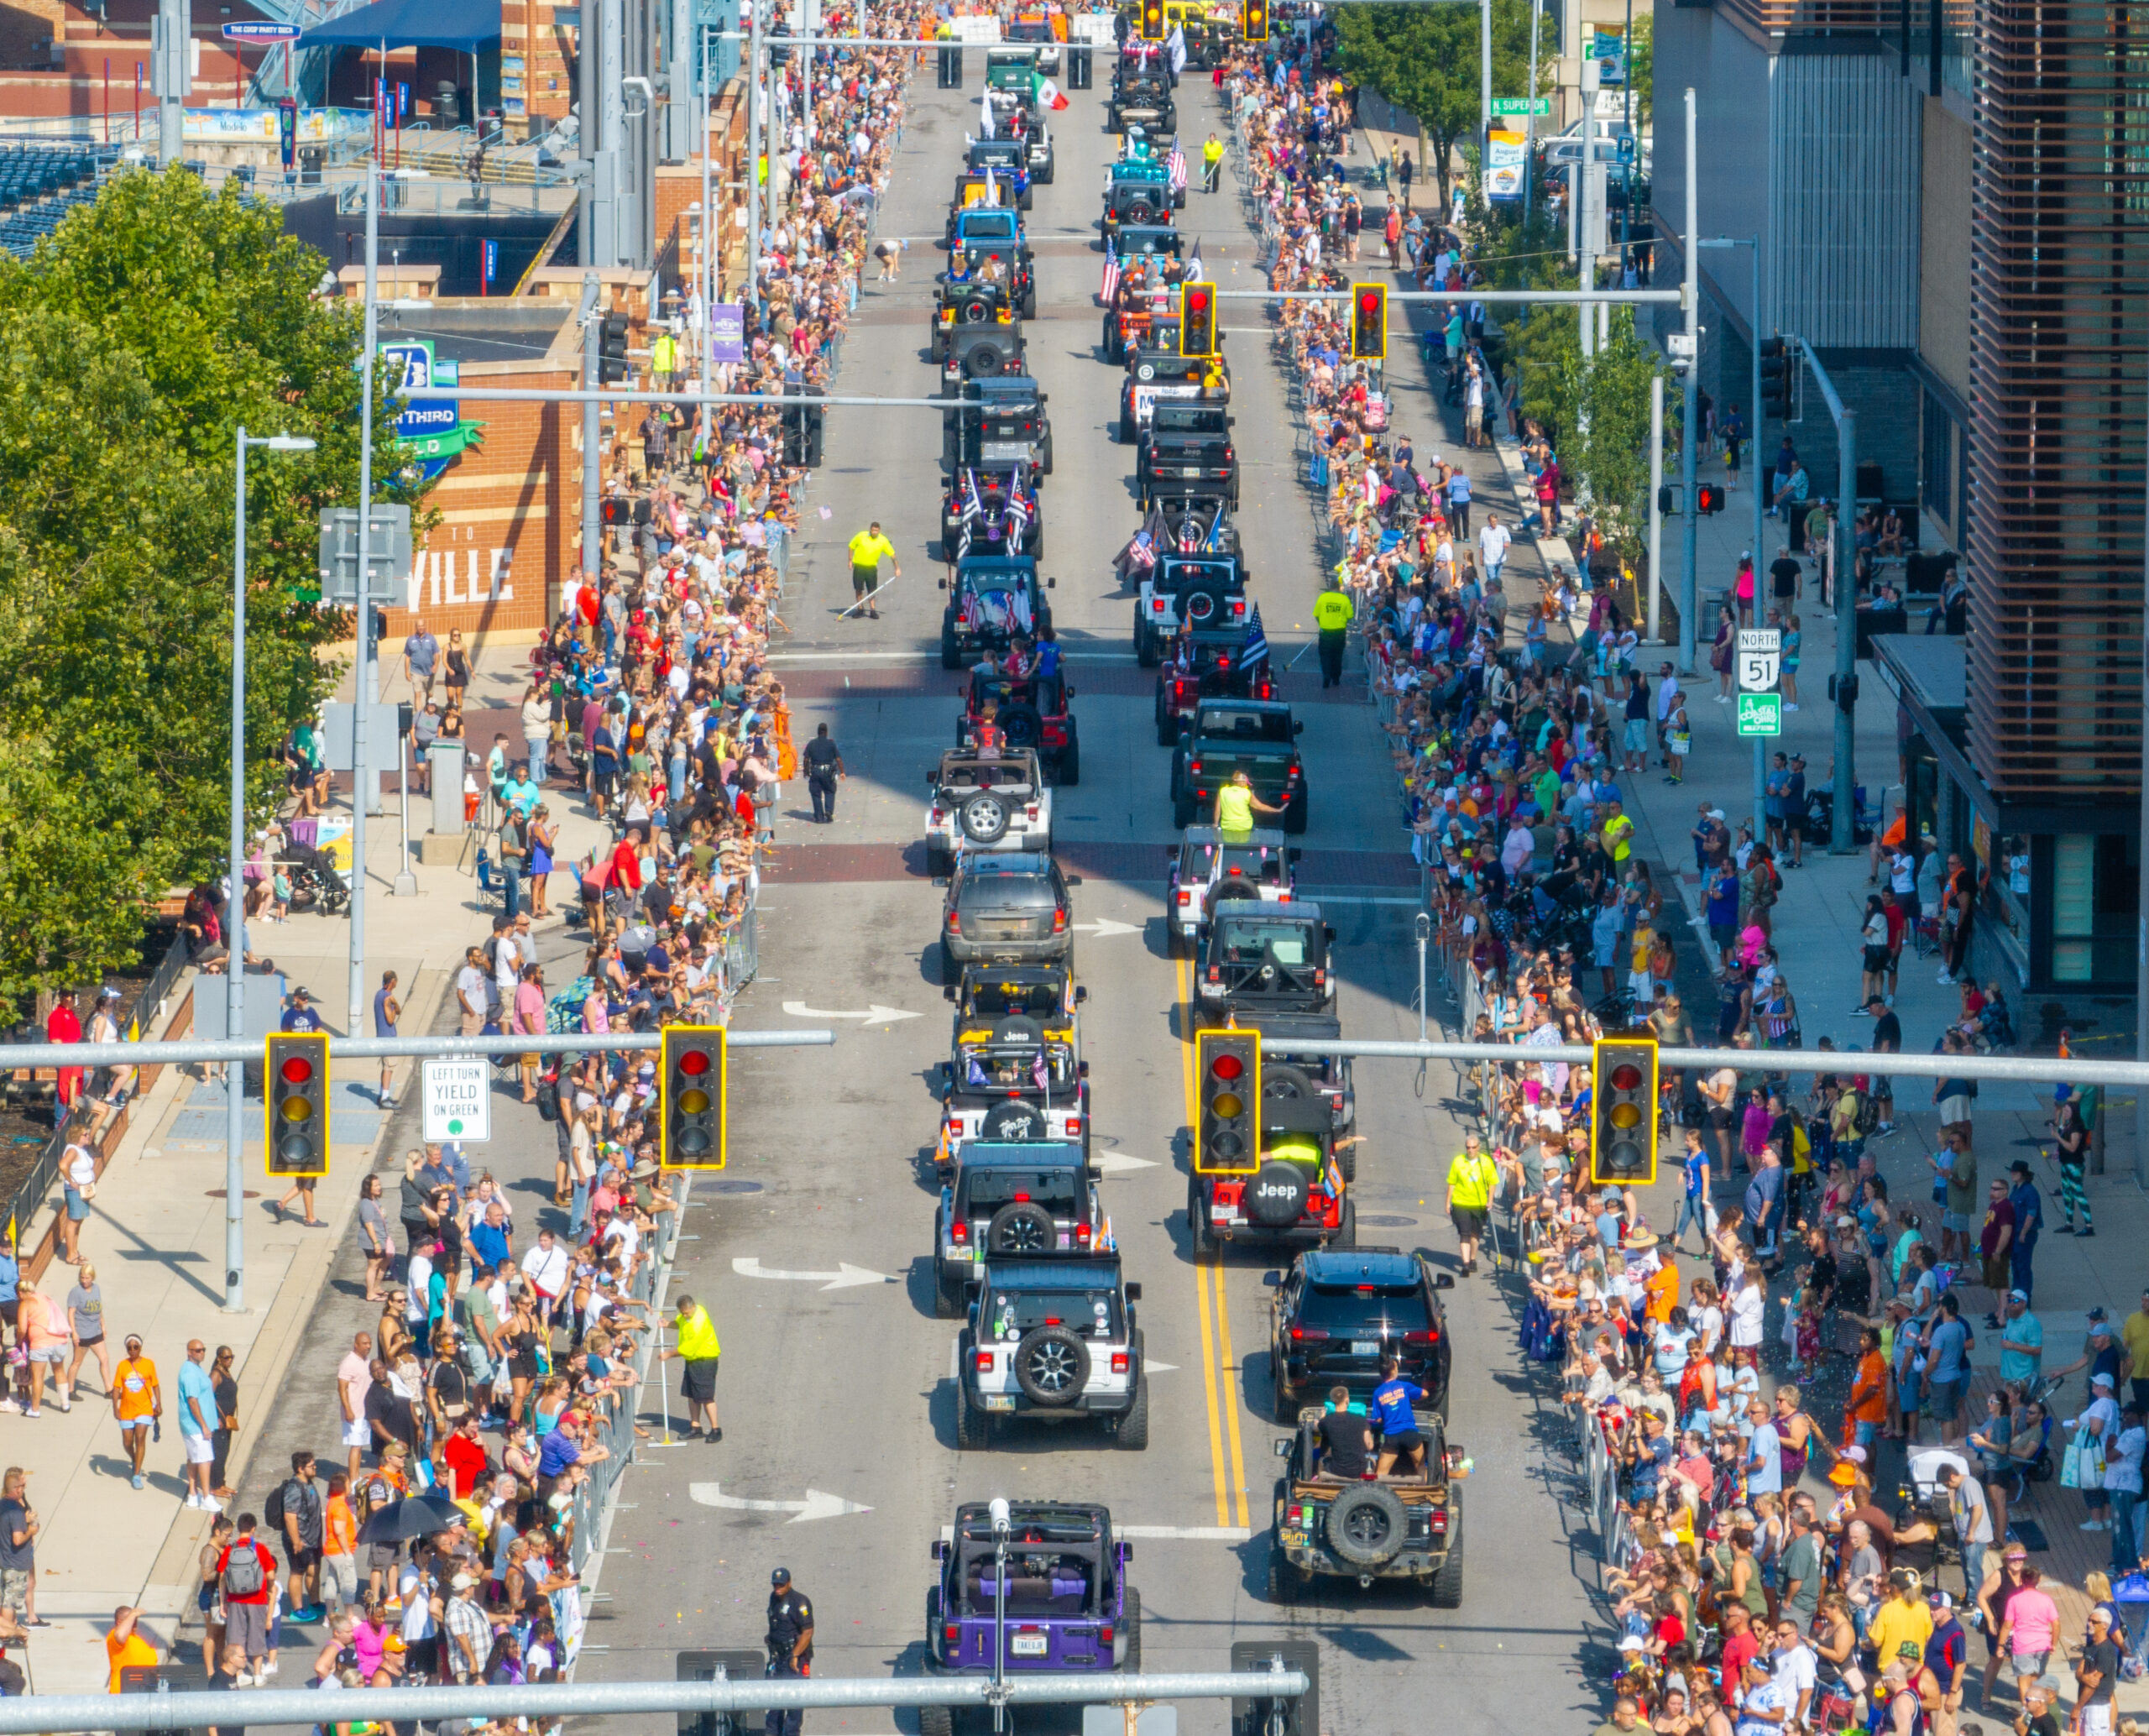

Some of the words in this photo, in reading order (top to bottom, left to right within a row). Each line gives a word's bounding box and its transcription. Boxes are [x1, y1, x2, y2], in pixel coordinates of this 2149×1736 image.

[1493, 100, 1501, 110] N.
[1503, 100, 1546, 111] SUPEROR
[405, 410, 454, 424] THIRD
[1183, 447, 1201, 457] Jeep
[452, 526, 473, 541] TO
[1742, 634, 1778, 646] NORTH
[1749, 660, 1770, 682] 51
[984, 732, 993, 748] 5
[1004, 1031, 1029, 1043] Jeep
[432, 1068, 455, 1080] LEFT
[457, 1068, 480, 1080] TURN
[436, 1085, 477, 1100] YIELD
[434, 1104, 446, 1116] ON
[449, 1103, 478, 1116] GREEN
[1257, 1182, 1298, 1200] Jeep
